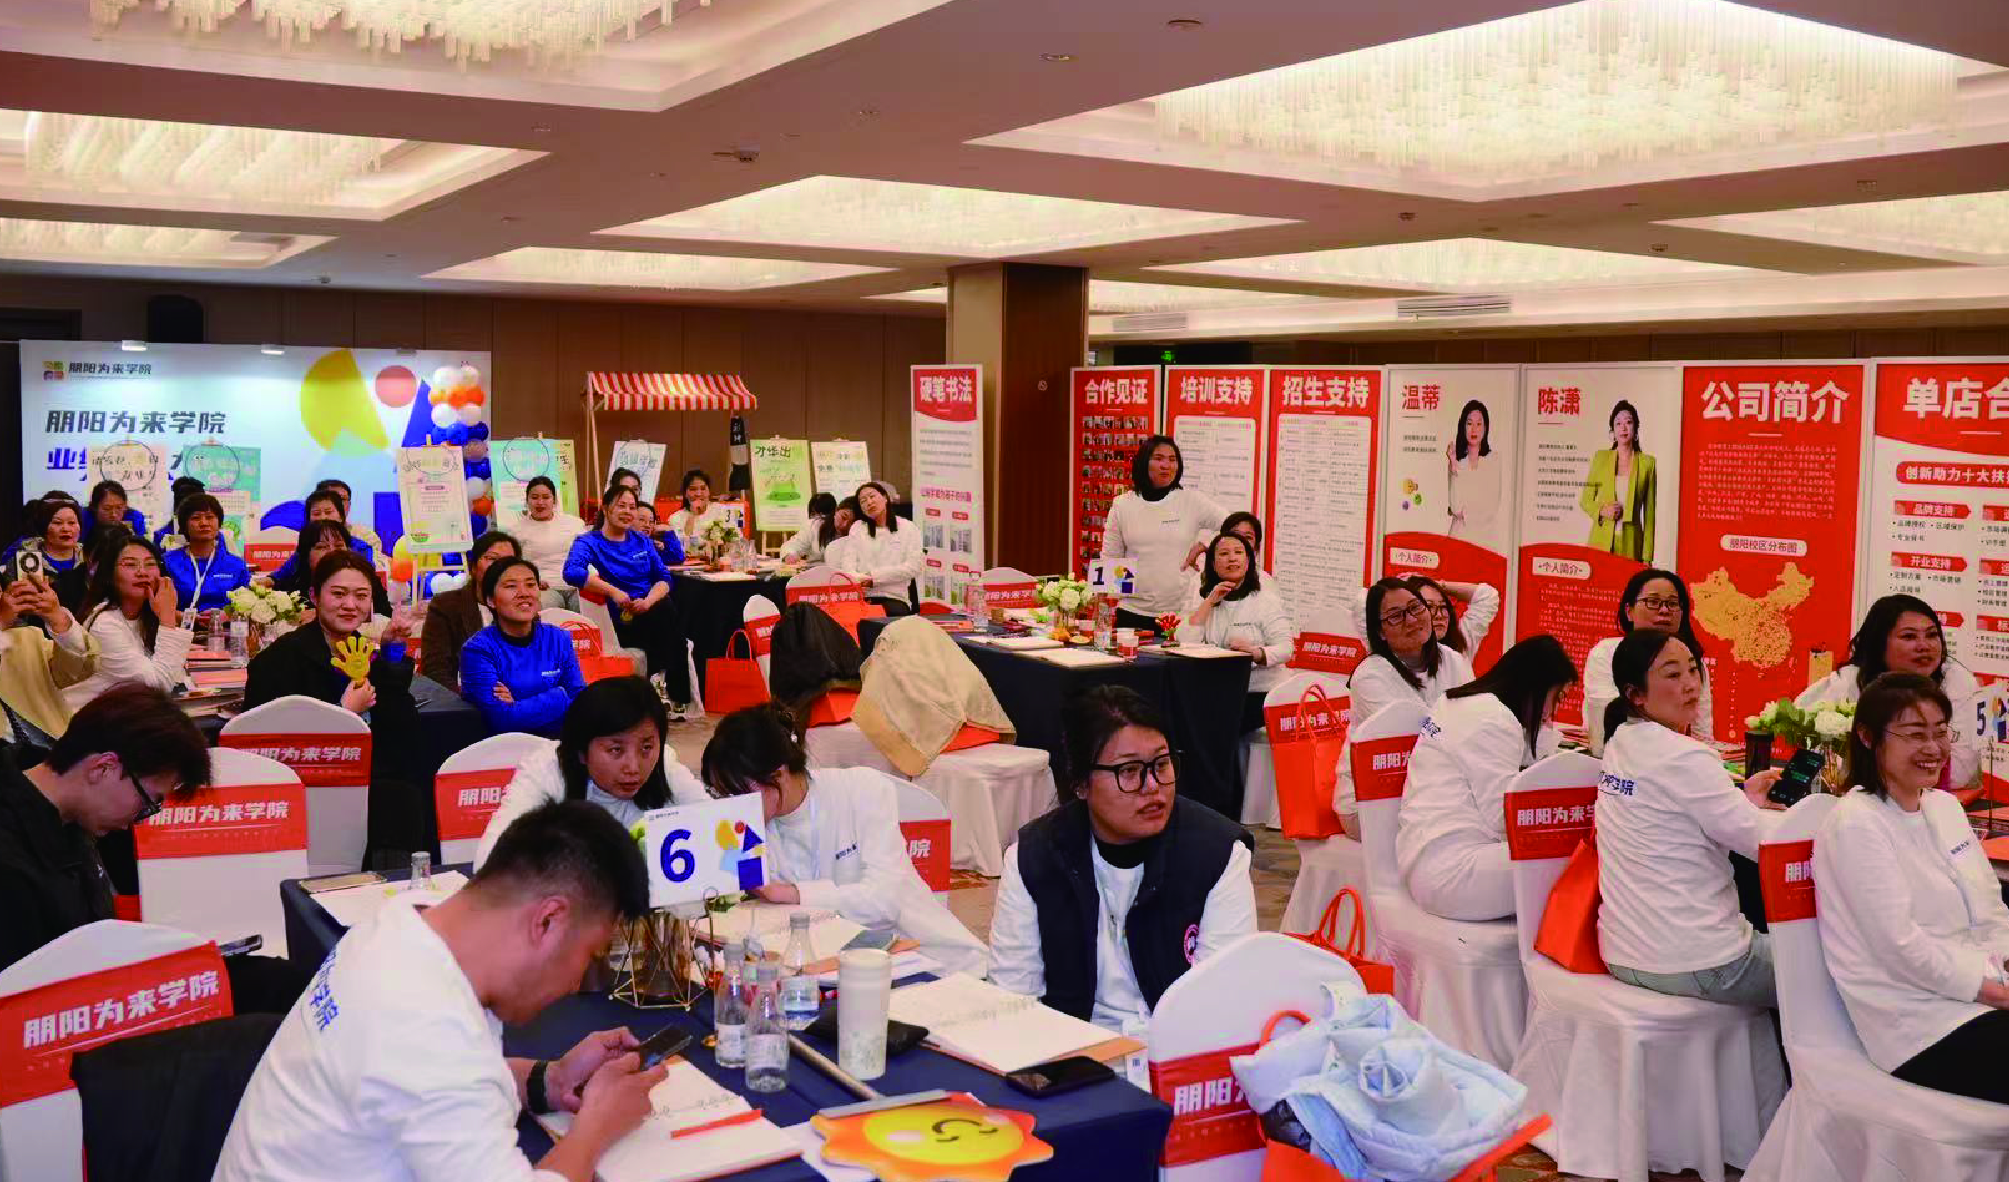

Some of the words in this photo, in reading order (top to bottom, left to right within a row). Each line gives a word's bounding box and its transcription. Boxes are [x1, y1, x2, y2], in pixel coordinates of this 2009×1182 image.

[69, 362, 151, 375] 朋阳为来学院
[920, 376, 972, 402] 硬笔书法
[1084, 378, 1148, 405] 合作见证
[1180, 375, 1254, 405] 培训支持
[1282, 375, 1369, 408] 招生支持
[1402, 384, 1441, 410] 温蒂
[1537, 388, 1581, 414] 陈潇
[1701, 380, 1850, 424] 公司简介
[45, 410, 227, 434] 朋阳为来学院
[1905, 465, 2009, 484] 创新助力十大扶
[1092, 566, 1105, 586] 1
[1541, 560, 1578, 576] 个人简介
[1976, 700, 1987, 737] 5
[660, 828, 696, 884] 6
[23, 970, 220, 1050] 朋阳为来学院
